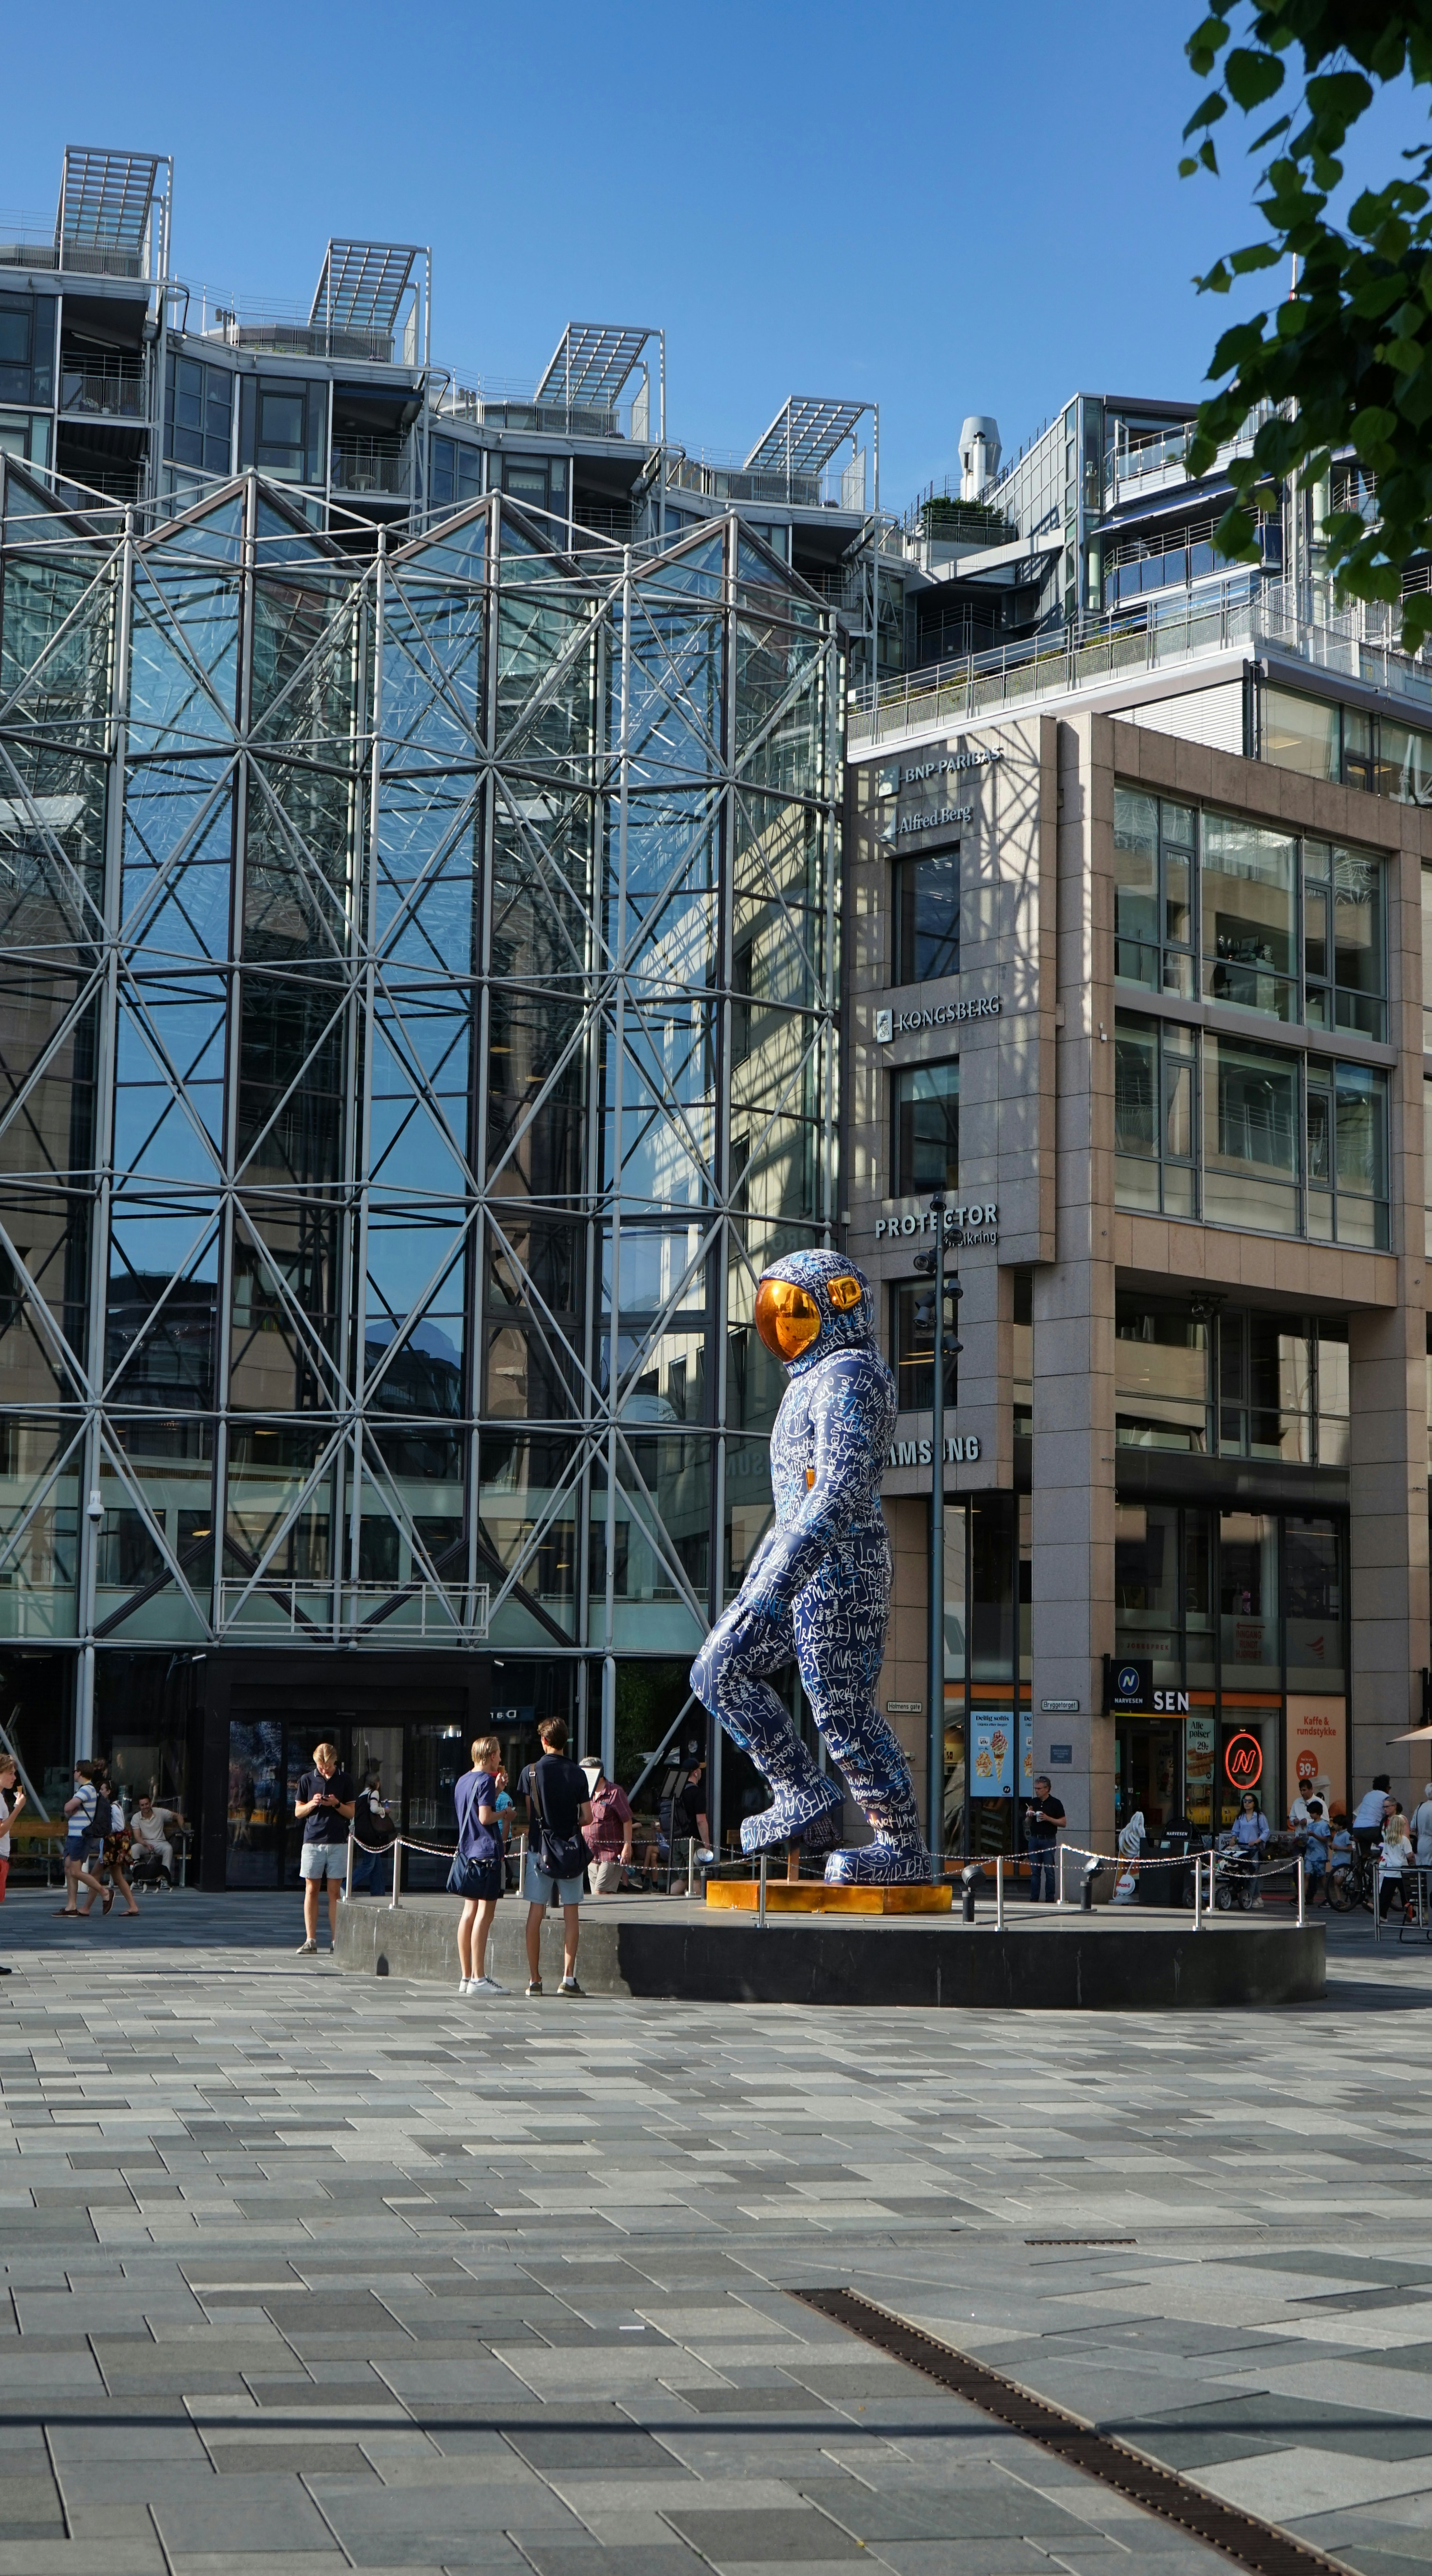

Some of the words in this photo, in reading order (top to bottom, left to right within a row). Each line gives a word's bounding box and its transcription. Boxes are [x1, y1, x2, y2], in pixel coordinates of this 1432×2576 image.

[906, 763, 935, 783] BNP
[938, 746, 1002, 773] PARIBAS
[899, 810, 938, 834] Alfred
[941, 806, 972, 822] Berg
[899, 995, 1000, 1031] KONGSBERG
[875, 1203, 997, 1238] PROTECTOR
[860, 1541, 885, 1565] LOVE
[1191, 1721, 1204, 1730] Alle
[1297, 1727, 1336, 1738] rundstykke
[1304, 1716, 1322, 1726] Kaffe
[1324, 1717, 1329, 1726] &
[1189, 1730, 1211, 1739] pølser
